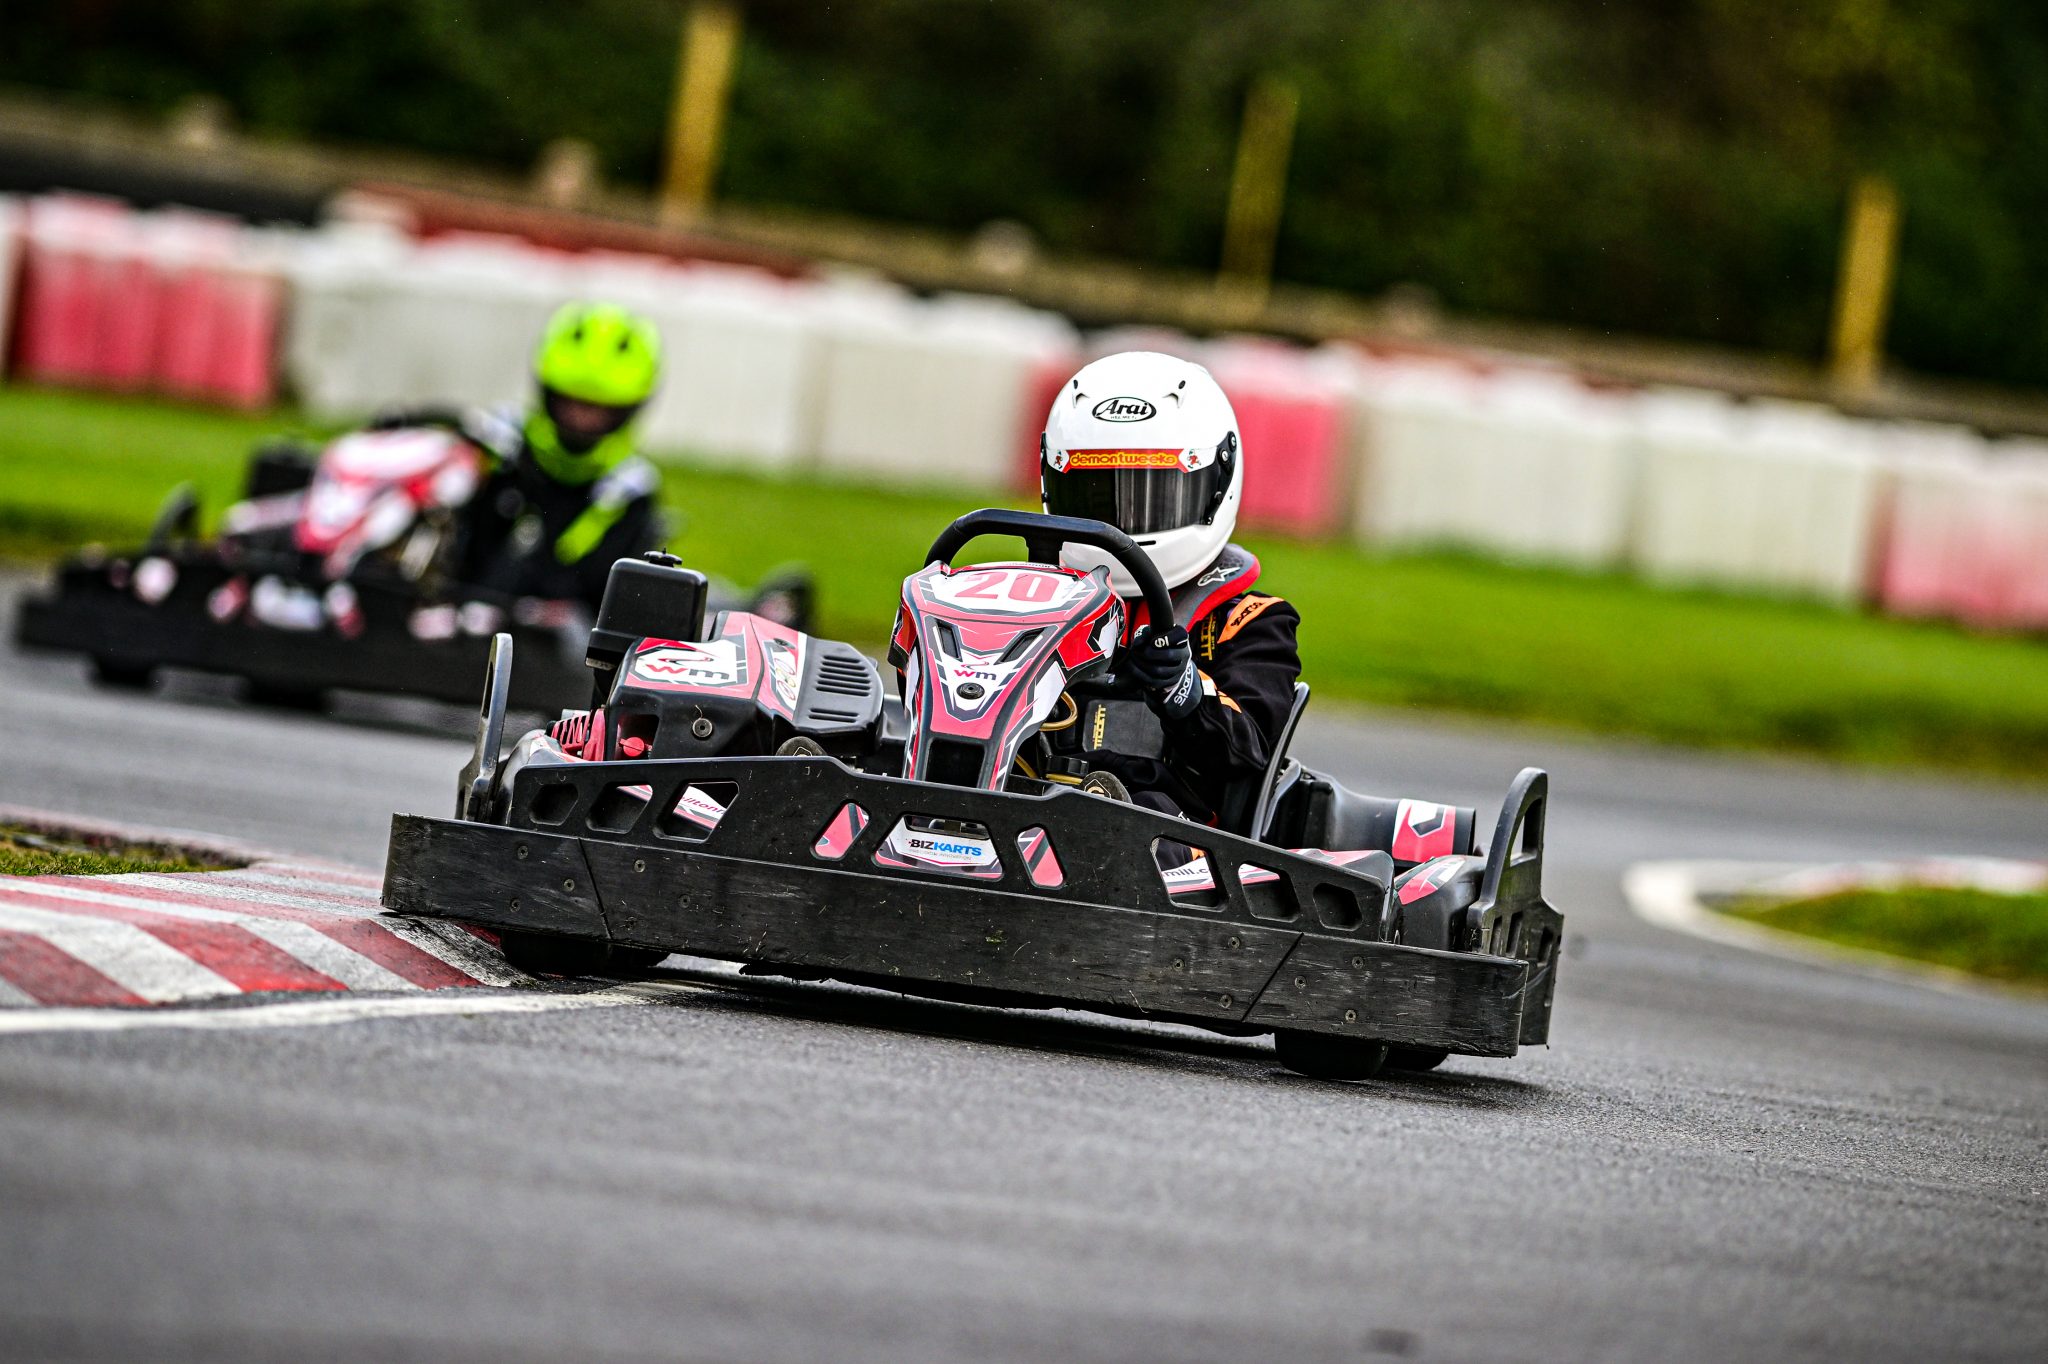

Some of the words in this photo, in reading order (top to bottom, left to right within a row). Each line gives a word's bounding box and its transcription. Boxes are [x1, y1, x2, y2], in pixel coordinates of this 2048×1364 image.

[1096, 400, 1148, 416] Arai
[1070, 453, 1178, 466] demontweeks
[954, 572, 1060, 602] 20
[682, 797, 725, 815] ilton
[910, 839, 982, 856] BIZKARTS
